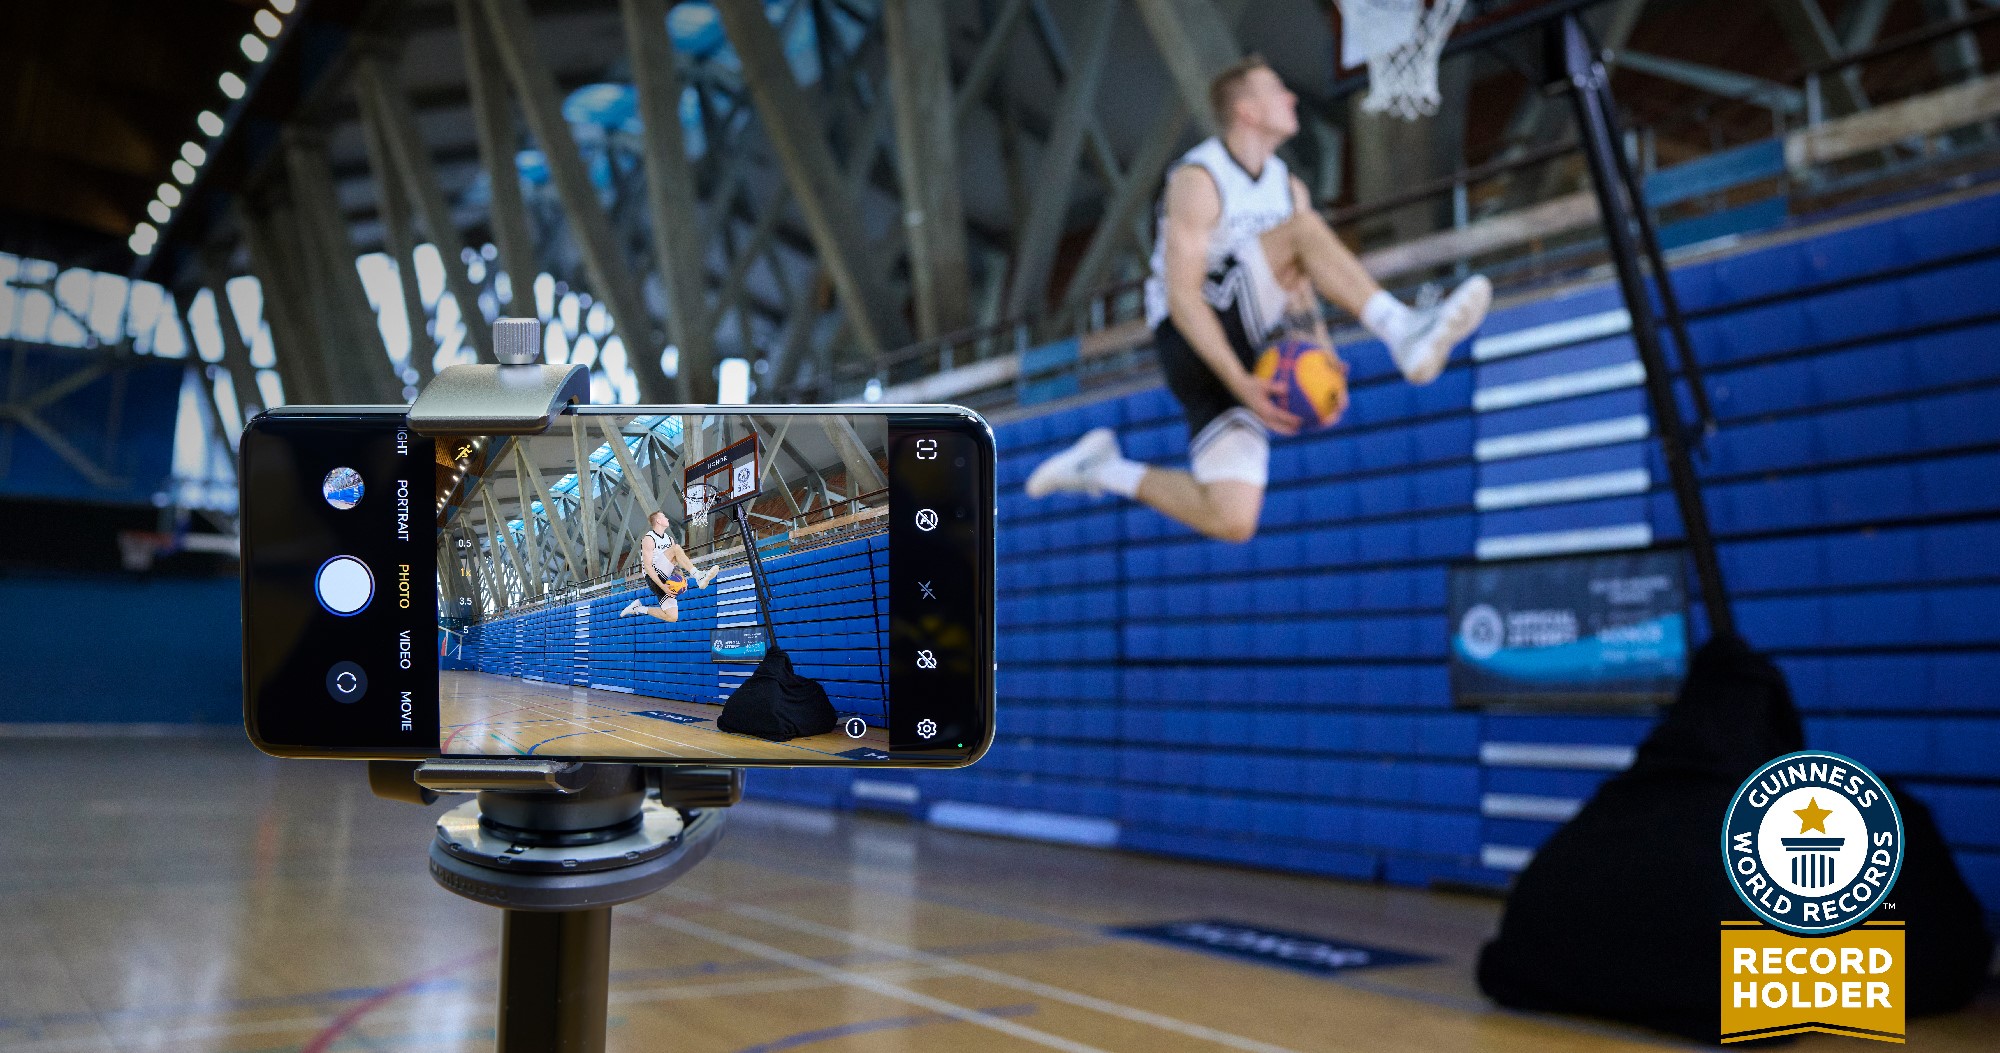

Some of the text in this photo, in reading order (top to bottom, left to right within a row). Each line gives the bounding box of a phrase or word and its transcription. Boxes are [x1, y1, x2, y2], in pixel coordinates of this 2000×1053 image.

[397, 427, 408, 456] IGHT
[397, 480, 409, 542] PORTRAIT
[458, 540, 472, 548] 0.5
[398, 564, 410, 609] PHOTO
[459, 597, 473, 606] 3.5
[463, 626, 469, 634] 5
[399, 630, 411, 669] VIDEO
[401, 691, 412, 731] MOVIE
